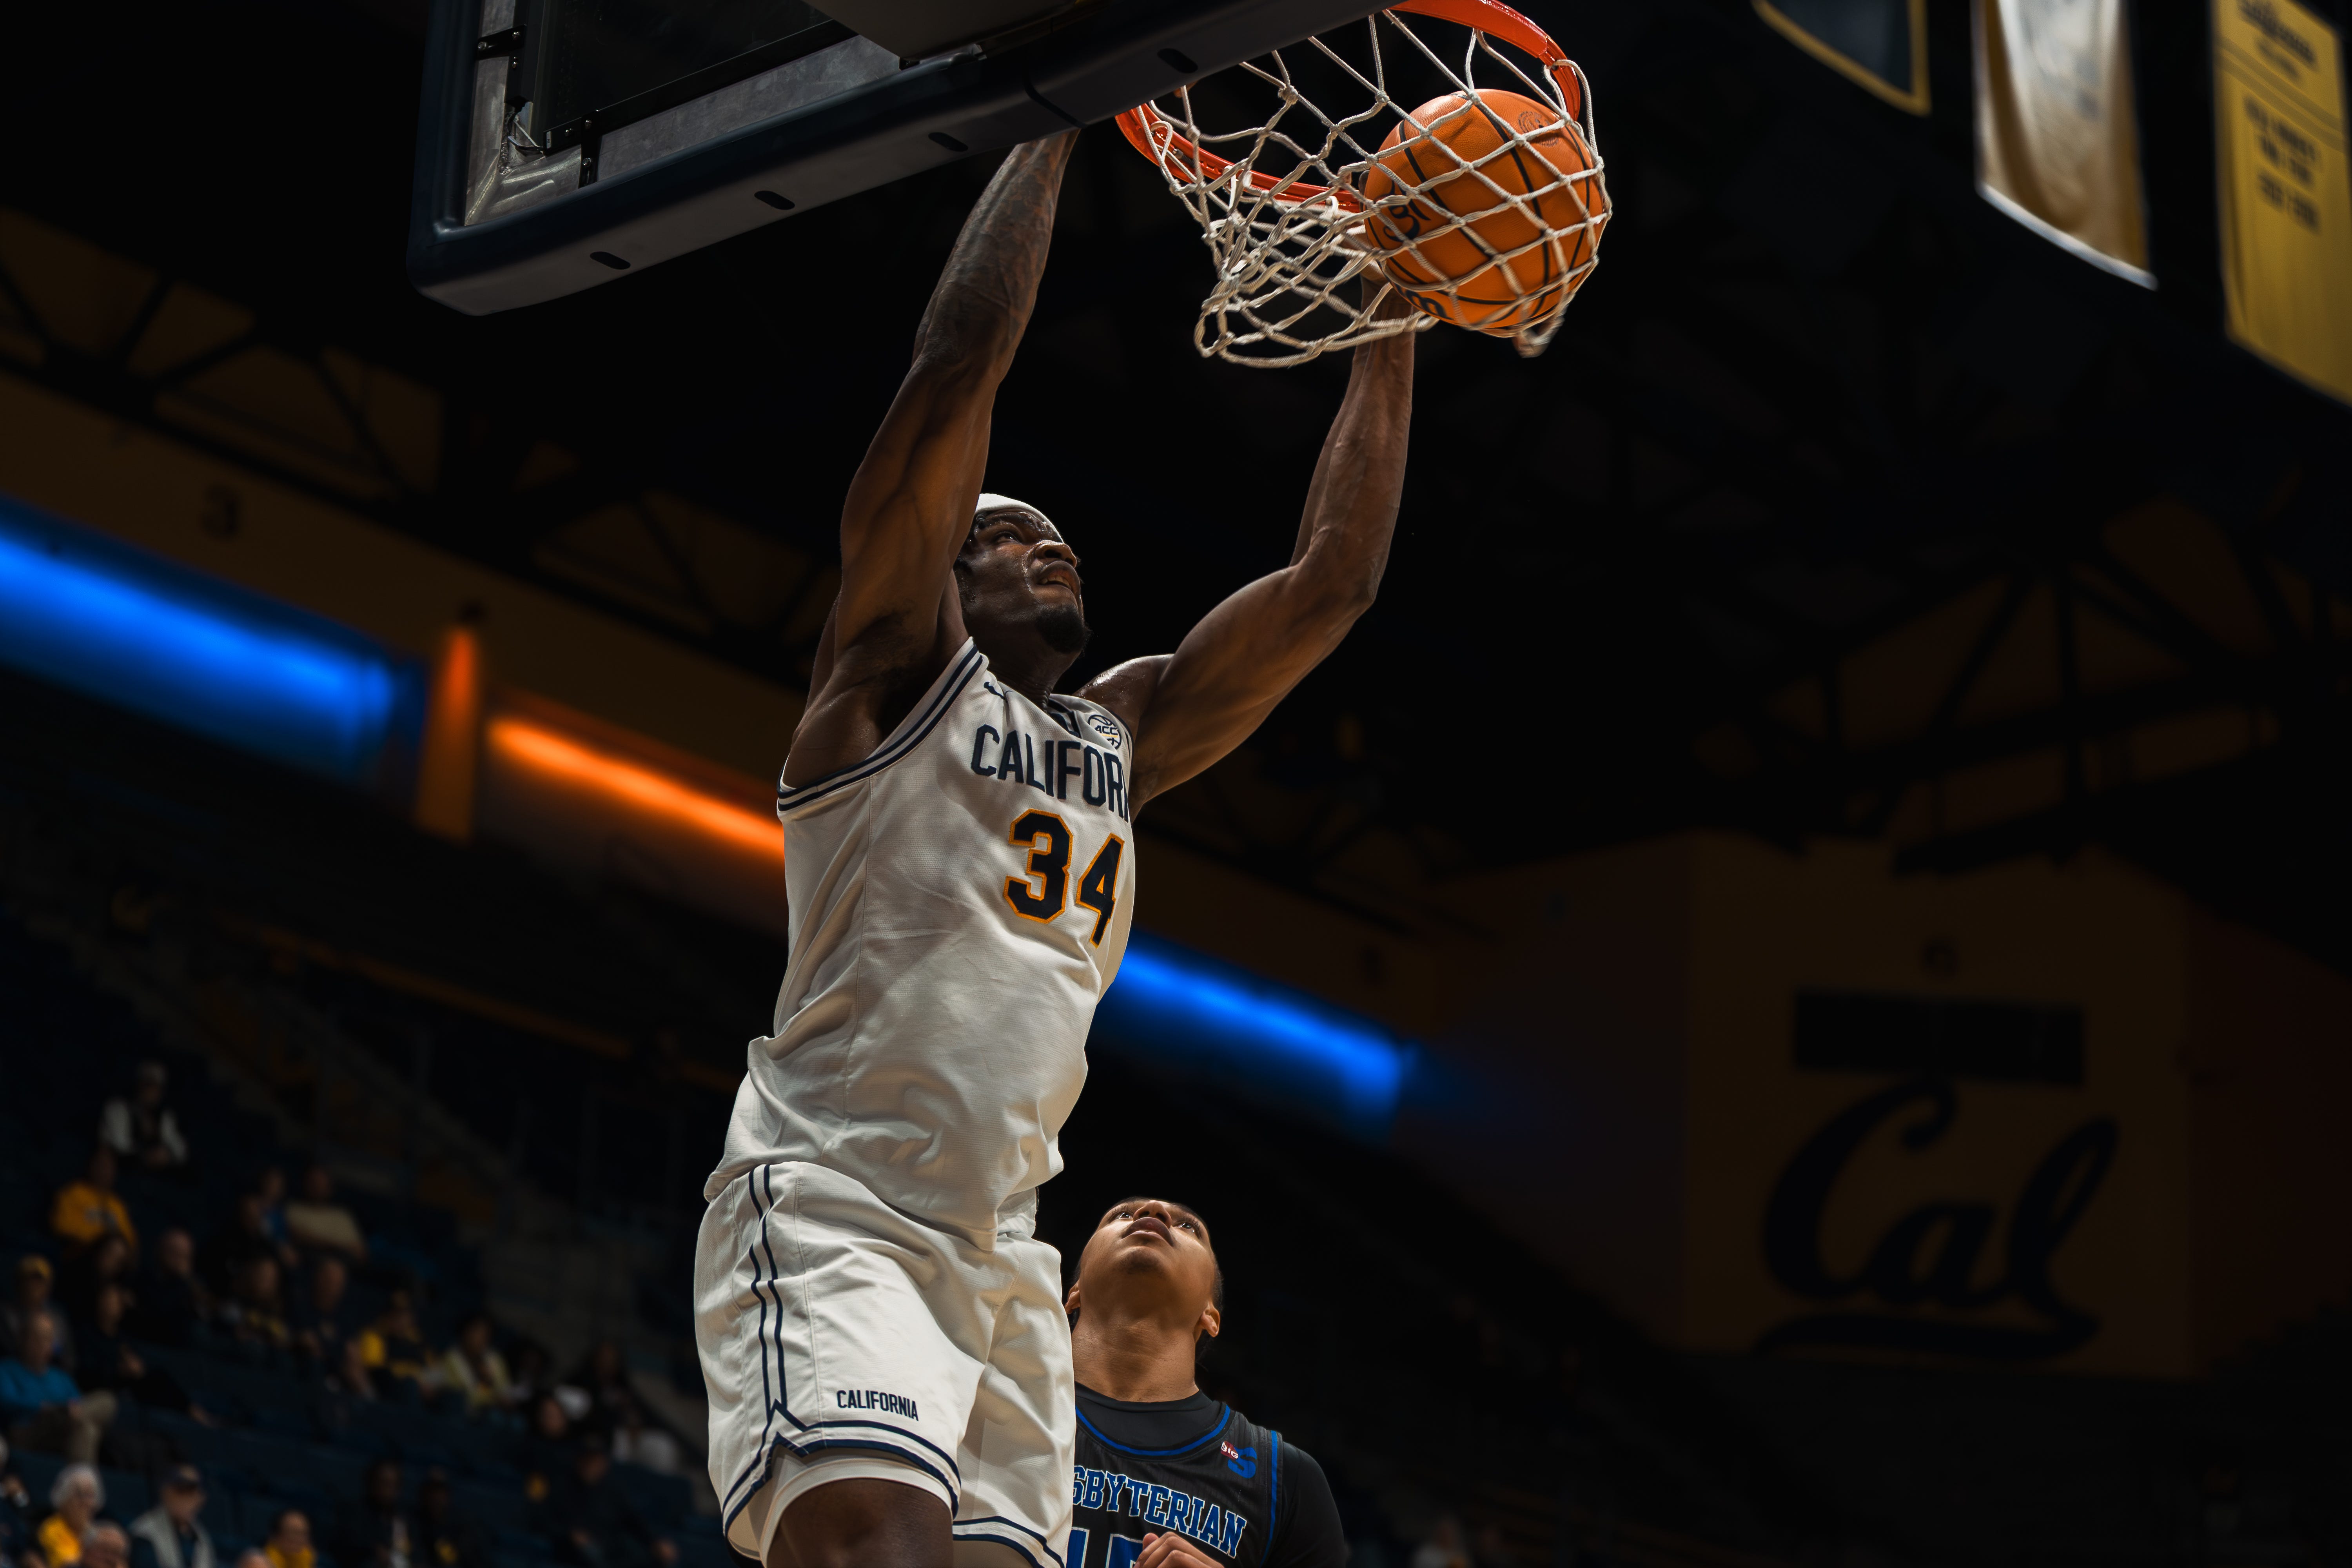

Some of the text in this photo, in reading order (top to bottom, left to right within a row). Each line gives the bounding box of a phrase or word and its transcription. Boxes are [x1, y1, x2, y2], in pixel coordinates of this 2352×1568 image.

[1095, 725, 1118, 735] ACC
[1004, 809, 1125, 948] 34
[1753, 1078, 2119, 1361] Cal
[837, 1390, 918, 1421] CALIFORNIA
[1221, 1442, 1239, 1459] BIG
